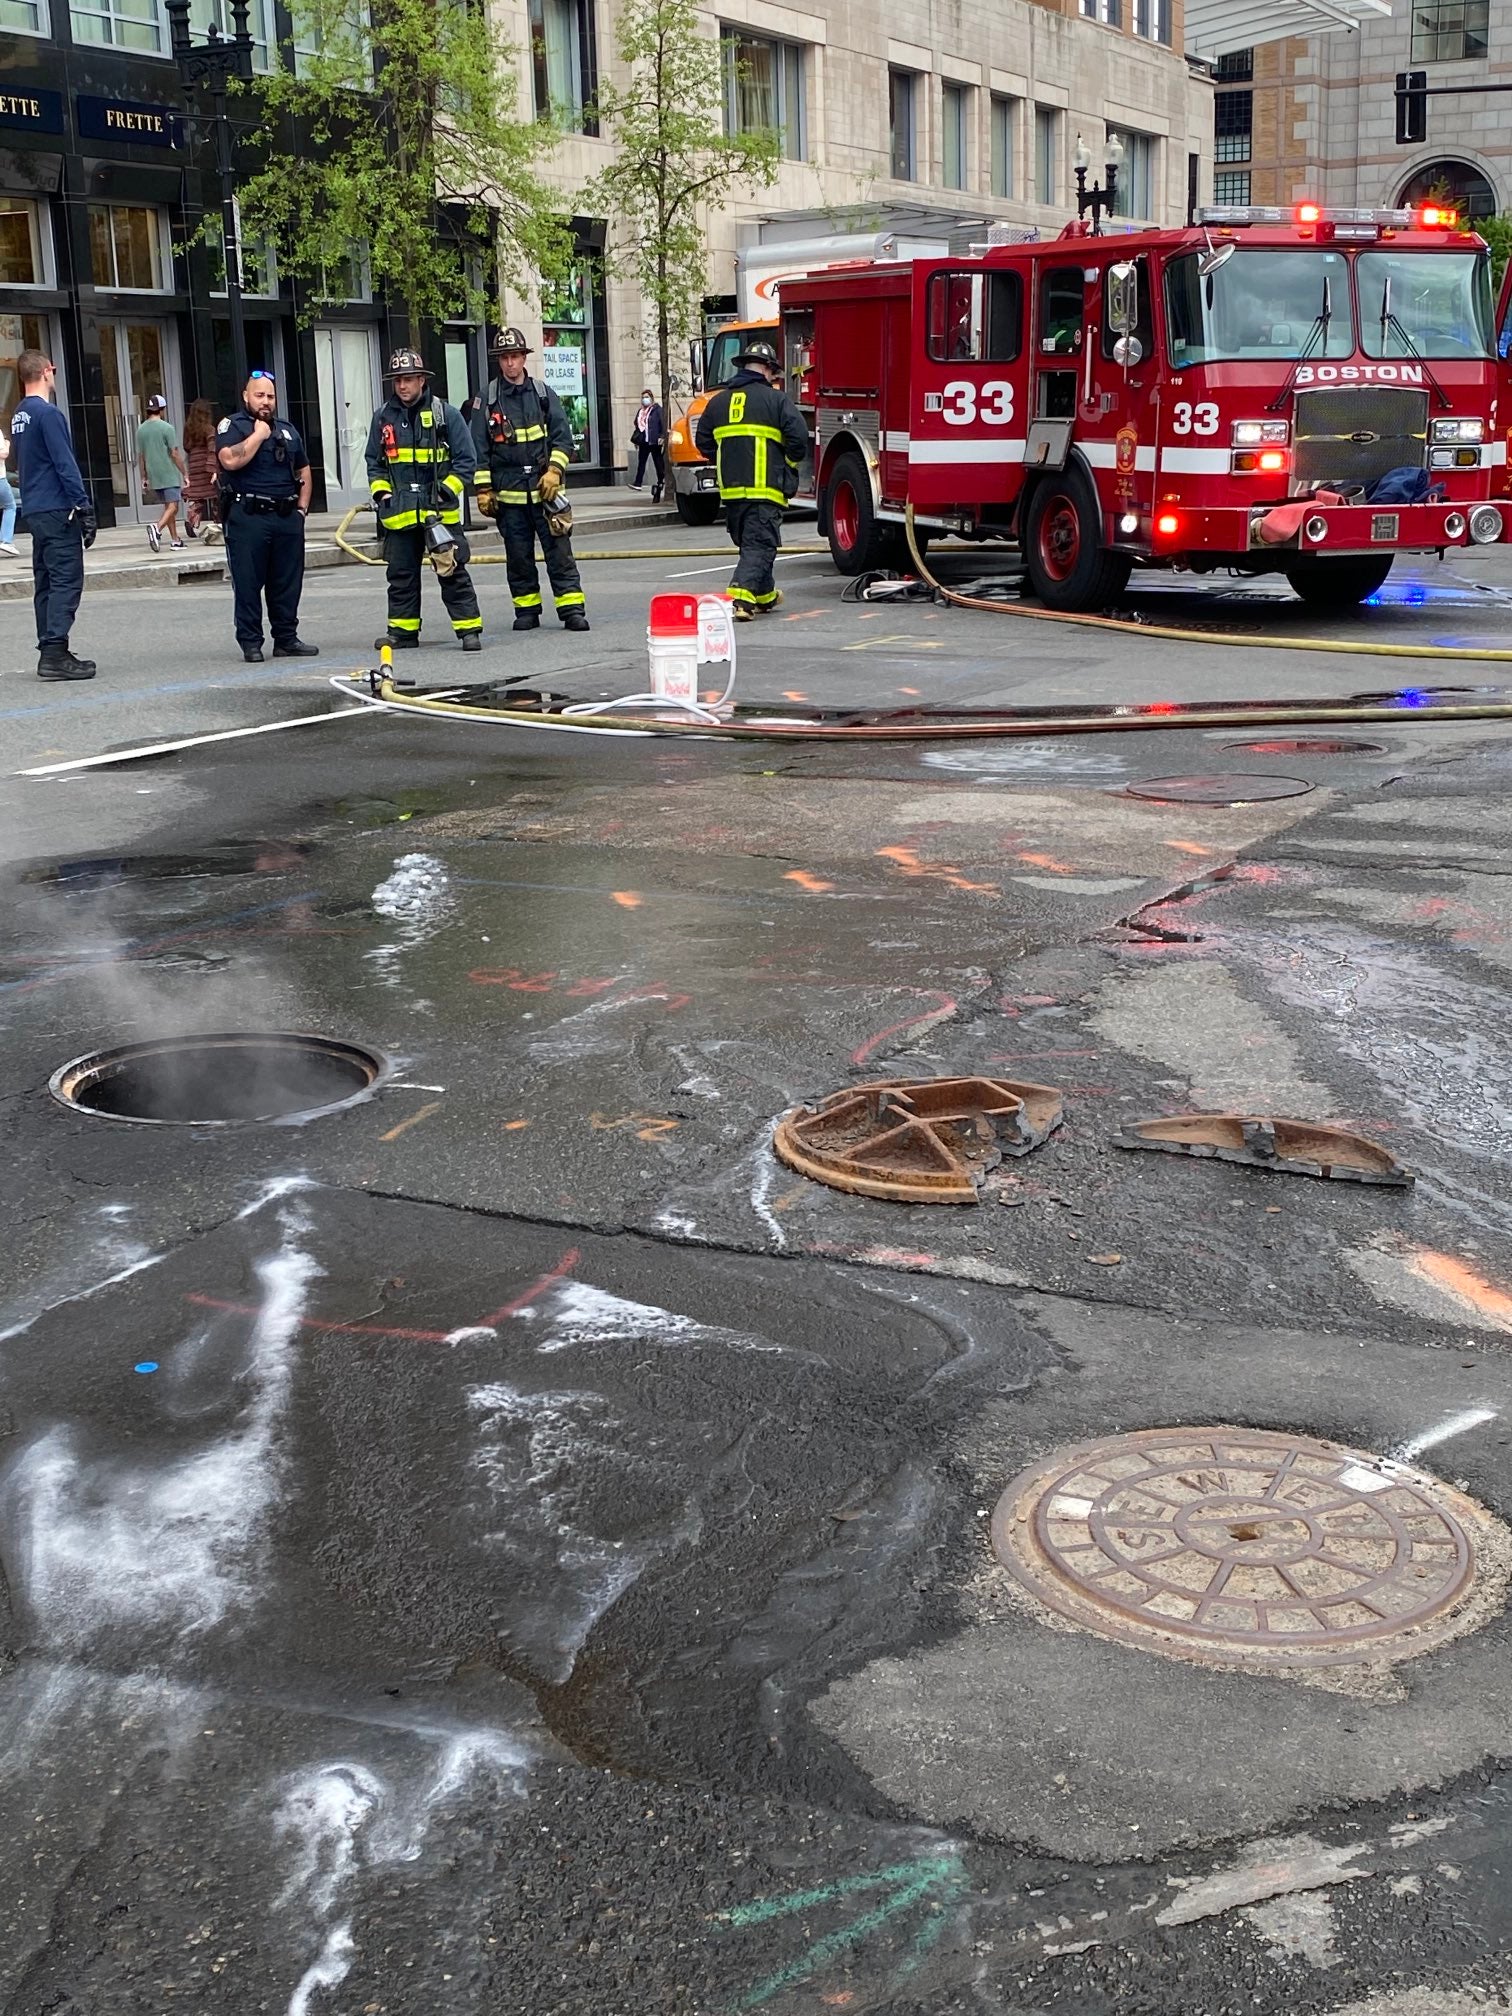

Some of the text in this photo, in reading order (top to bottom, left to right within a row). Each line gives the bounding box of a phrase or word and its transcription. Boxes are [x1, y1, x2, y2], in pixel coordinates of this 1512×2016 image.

[106, 109, 163, 132] FRETTE
[498, 334, 515, 346] 33
[392, 356, 409, 369] 33
[559, 353, 578, 363] SPACE
[556, 368, 575, 378] LEASE
[1296, 365, 1423, 383] BOSTON
[943, 381, 1014, 425] 33
[1173, 402, 1220, 435] 33
